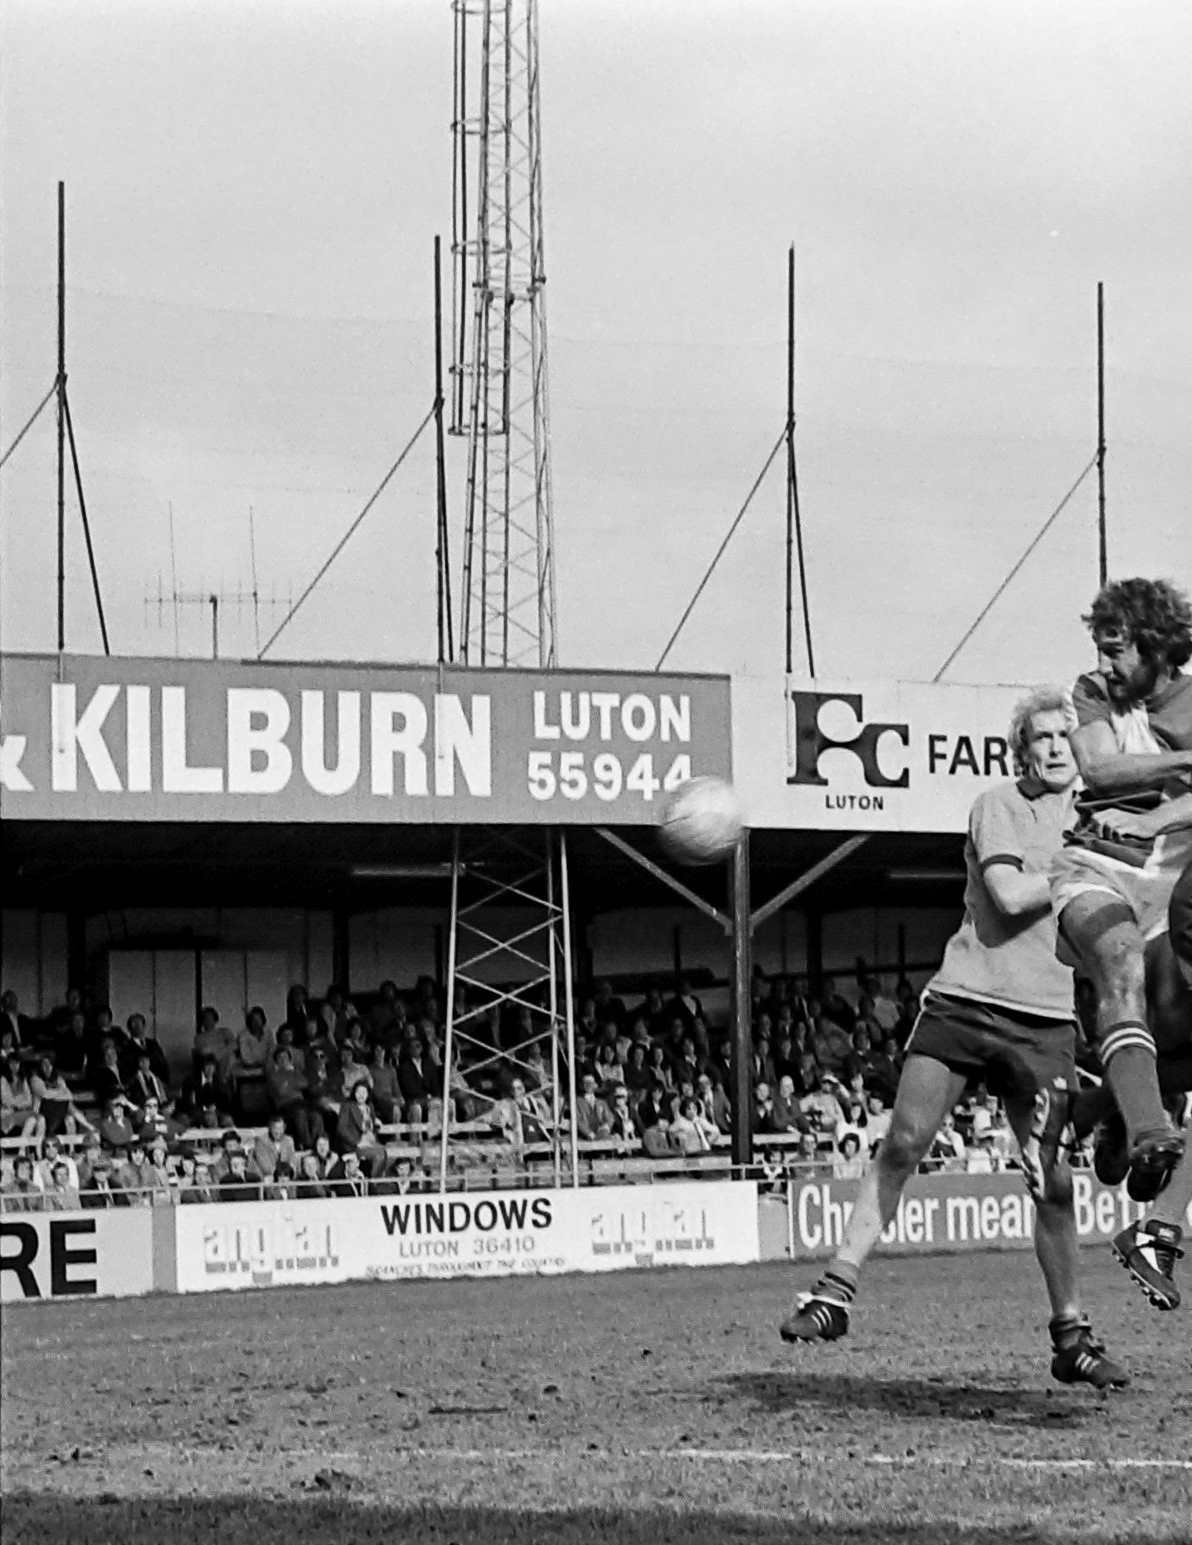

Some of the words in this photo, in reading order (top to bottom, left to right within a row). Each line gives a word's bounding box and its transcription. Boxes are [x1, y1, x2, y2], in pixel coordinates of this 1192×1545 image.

[533, 690, 691, 742] LUTON
[51, 683, 492, 797] KILBURN
[927, 733, 1022, 777] FAR
[527, 751, 692, 801] 55944
[824, 794, 885, 811] LUTON
[380, 1197, 553, 1236] WINDOWS
[0, 1218, 97, 1298] RE
[398, 1239, 460, 1259] LUTON
[473, 1235, 536, 1256] 36410
